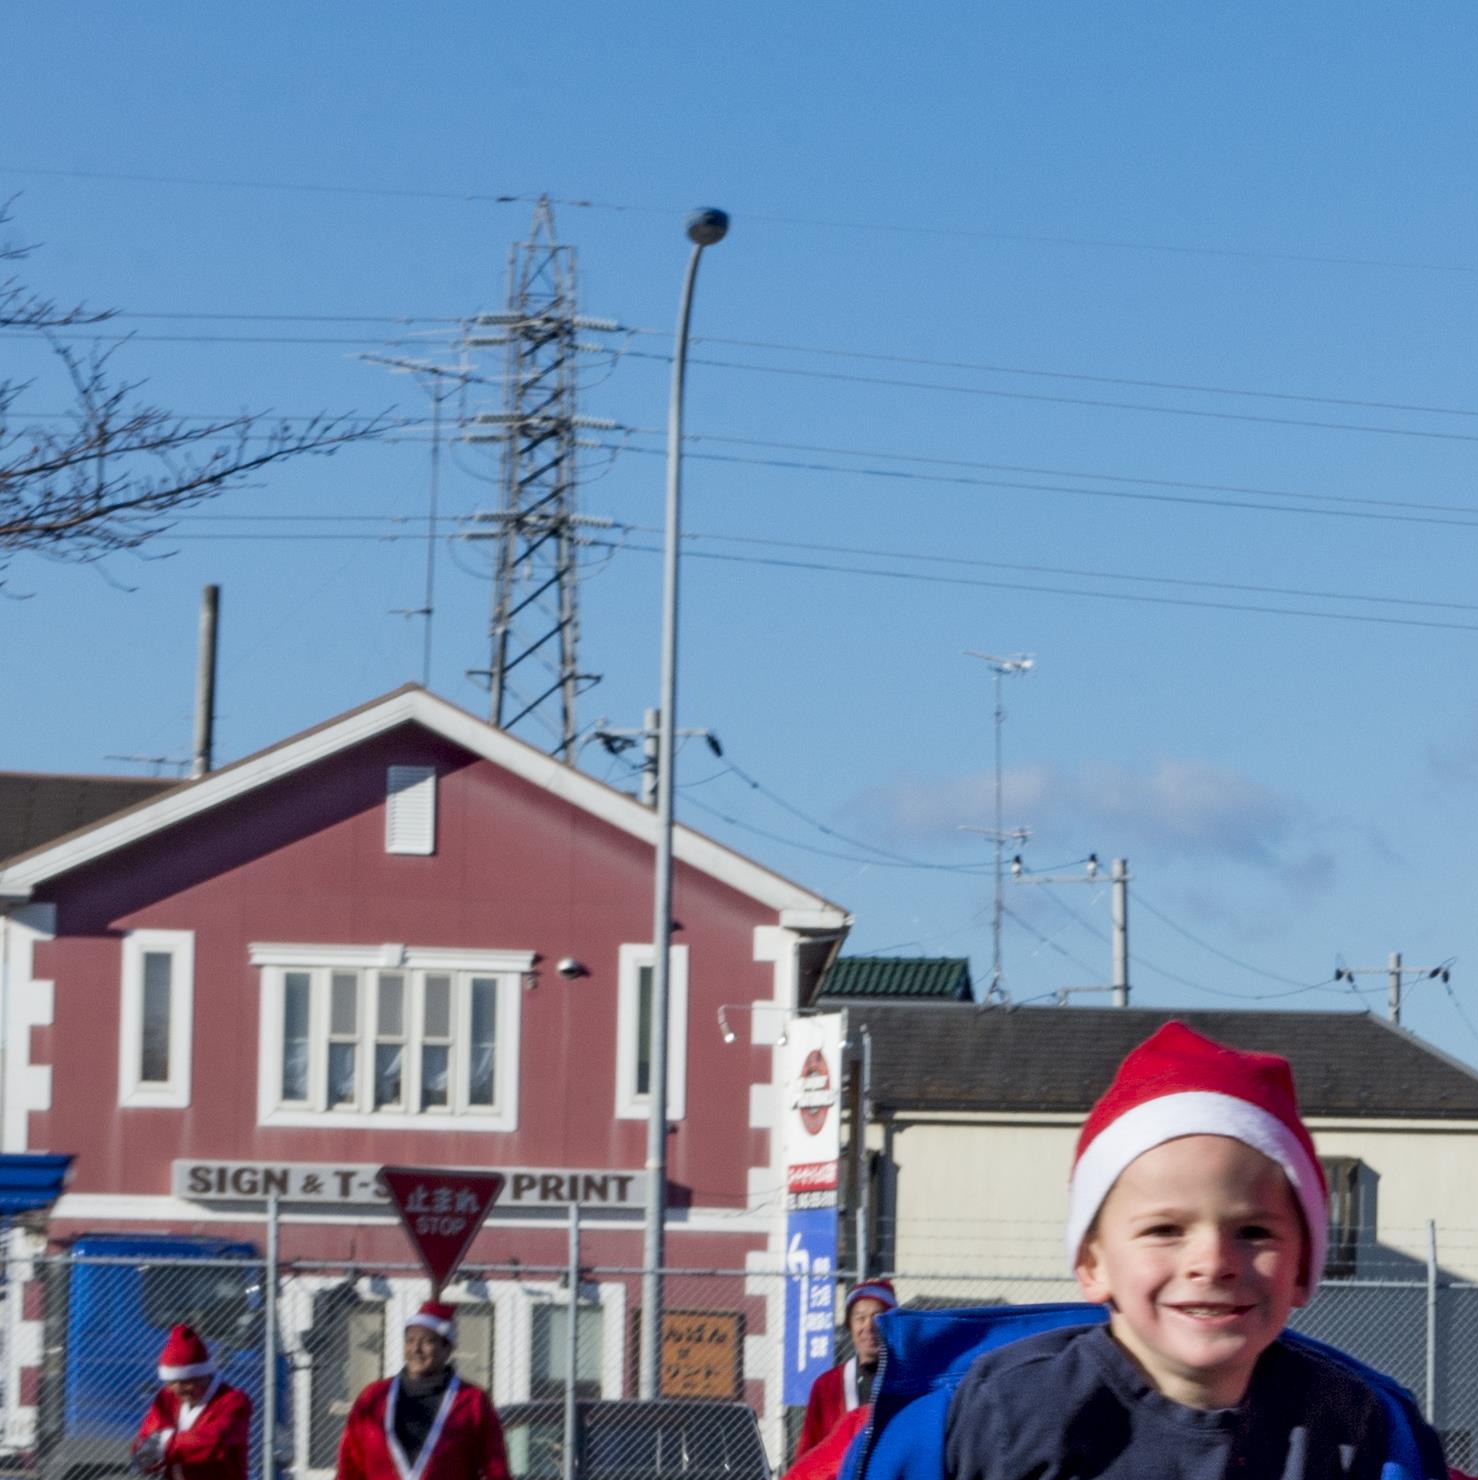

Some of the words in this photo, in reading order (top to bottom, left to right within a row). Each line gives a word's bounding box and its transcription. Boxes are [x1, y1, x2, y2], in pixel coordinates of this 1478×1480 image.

[188, 1167, 289, 1196] SIGN
[301, 1174, 323, 1195] &
[511, 1173, 635, 1202] PRINT
[404, 1184, 480, 1214] 止まれ
[416, 1215, 466, 1236] STOP
